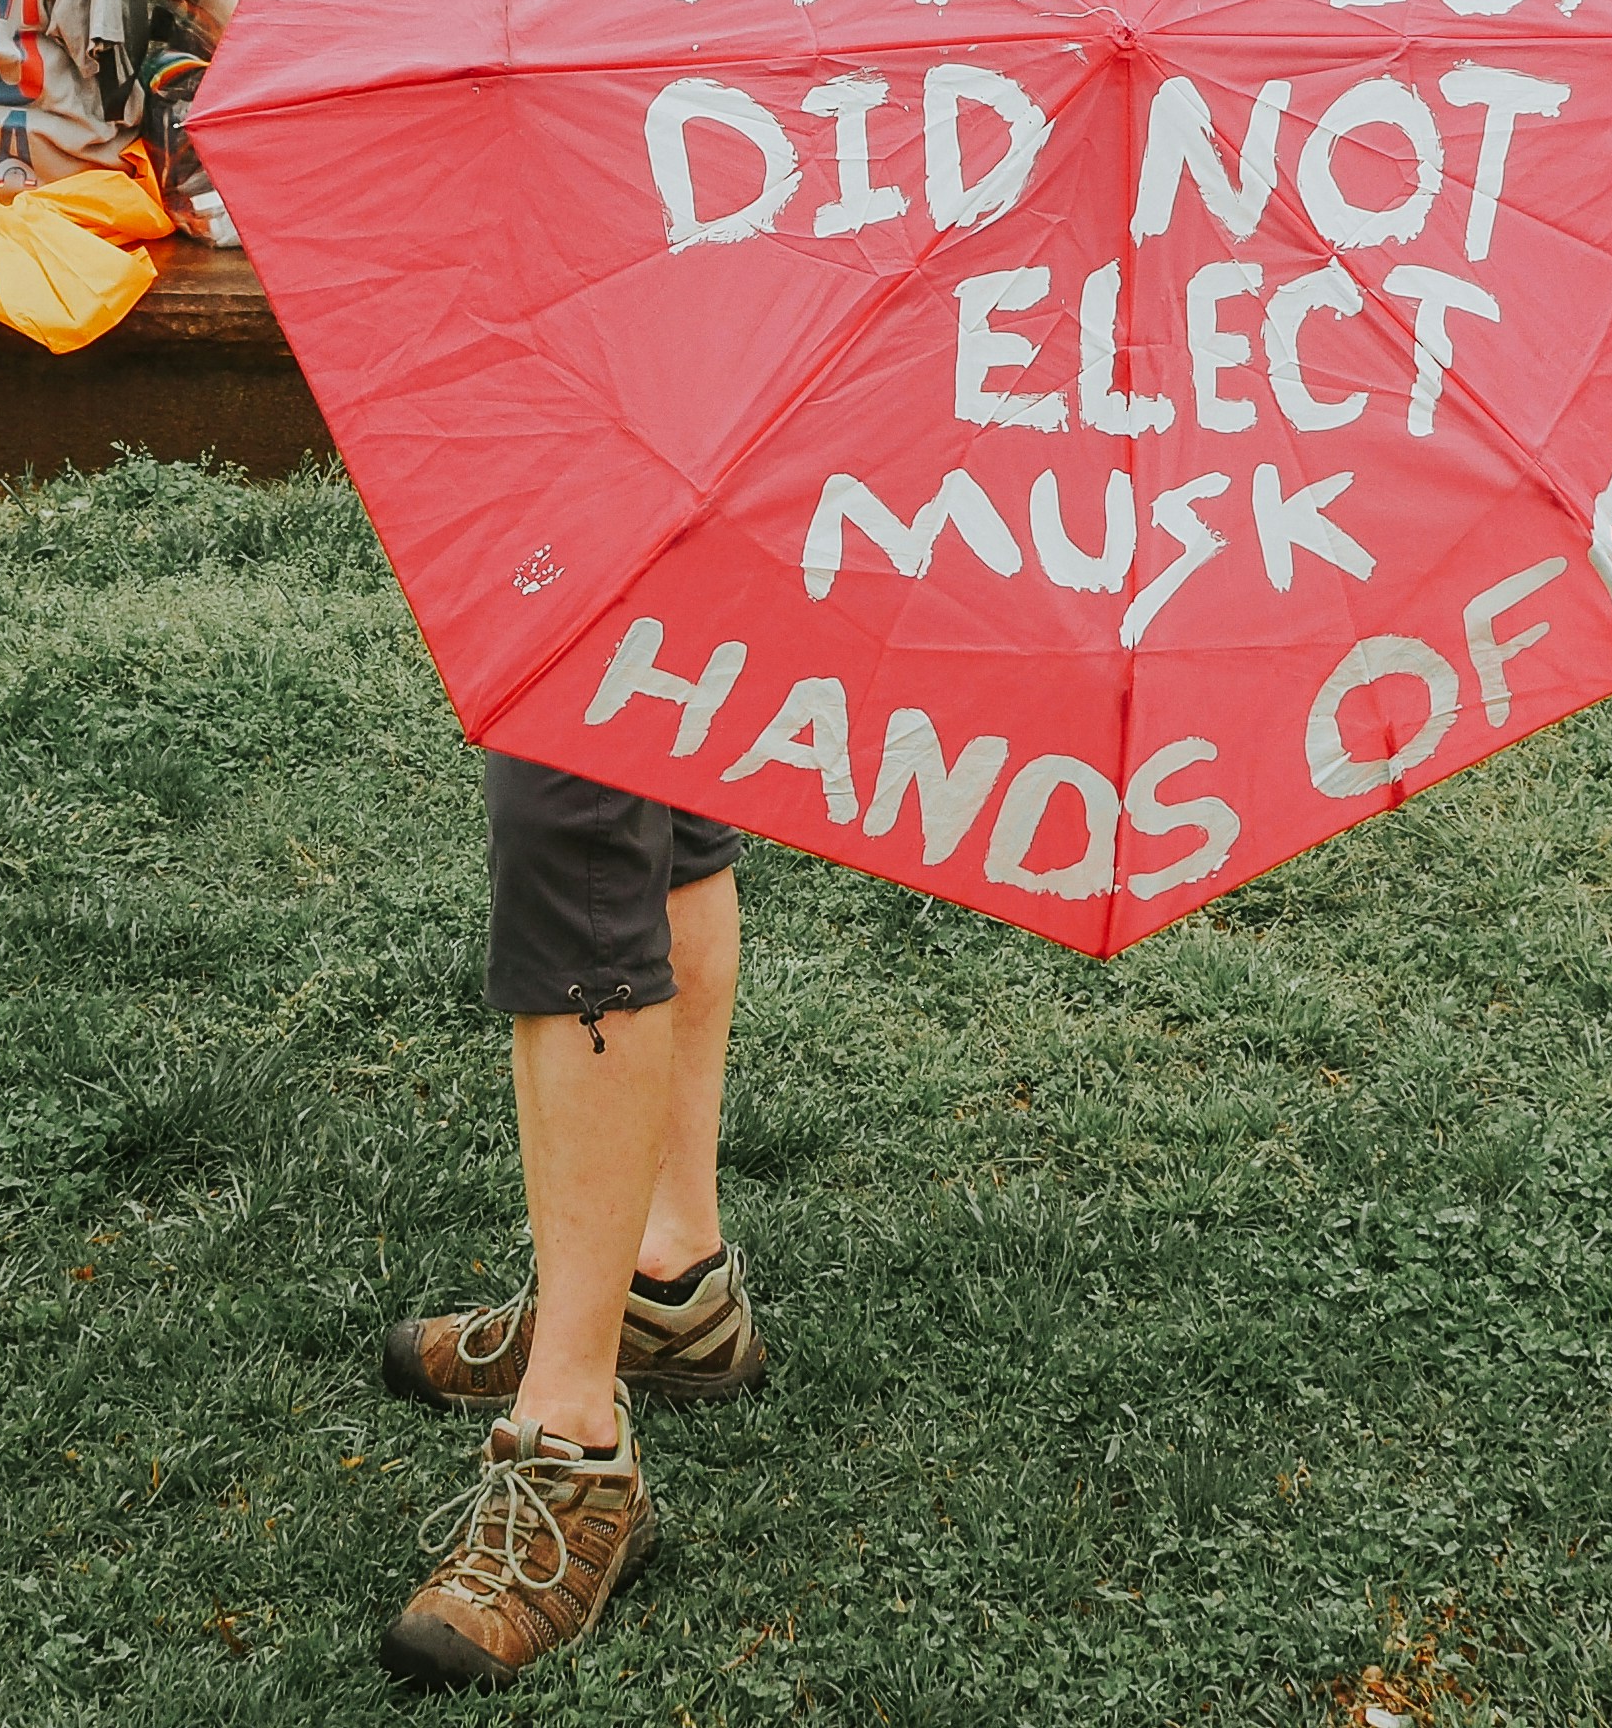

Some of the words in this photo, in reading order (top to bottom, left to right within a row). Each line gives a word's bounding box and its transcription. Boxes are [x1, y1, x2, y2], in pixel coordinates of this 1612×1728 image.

[643, 64, 1056, 253] DID
[1130, 60, 1572, 262] NOT
[952, 257, 1502, 438] ELECT
[801, 463, 1376, 650] MUSK
[583, 616, 1241, 902] HANDS
